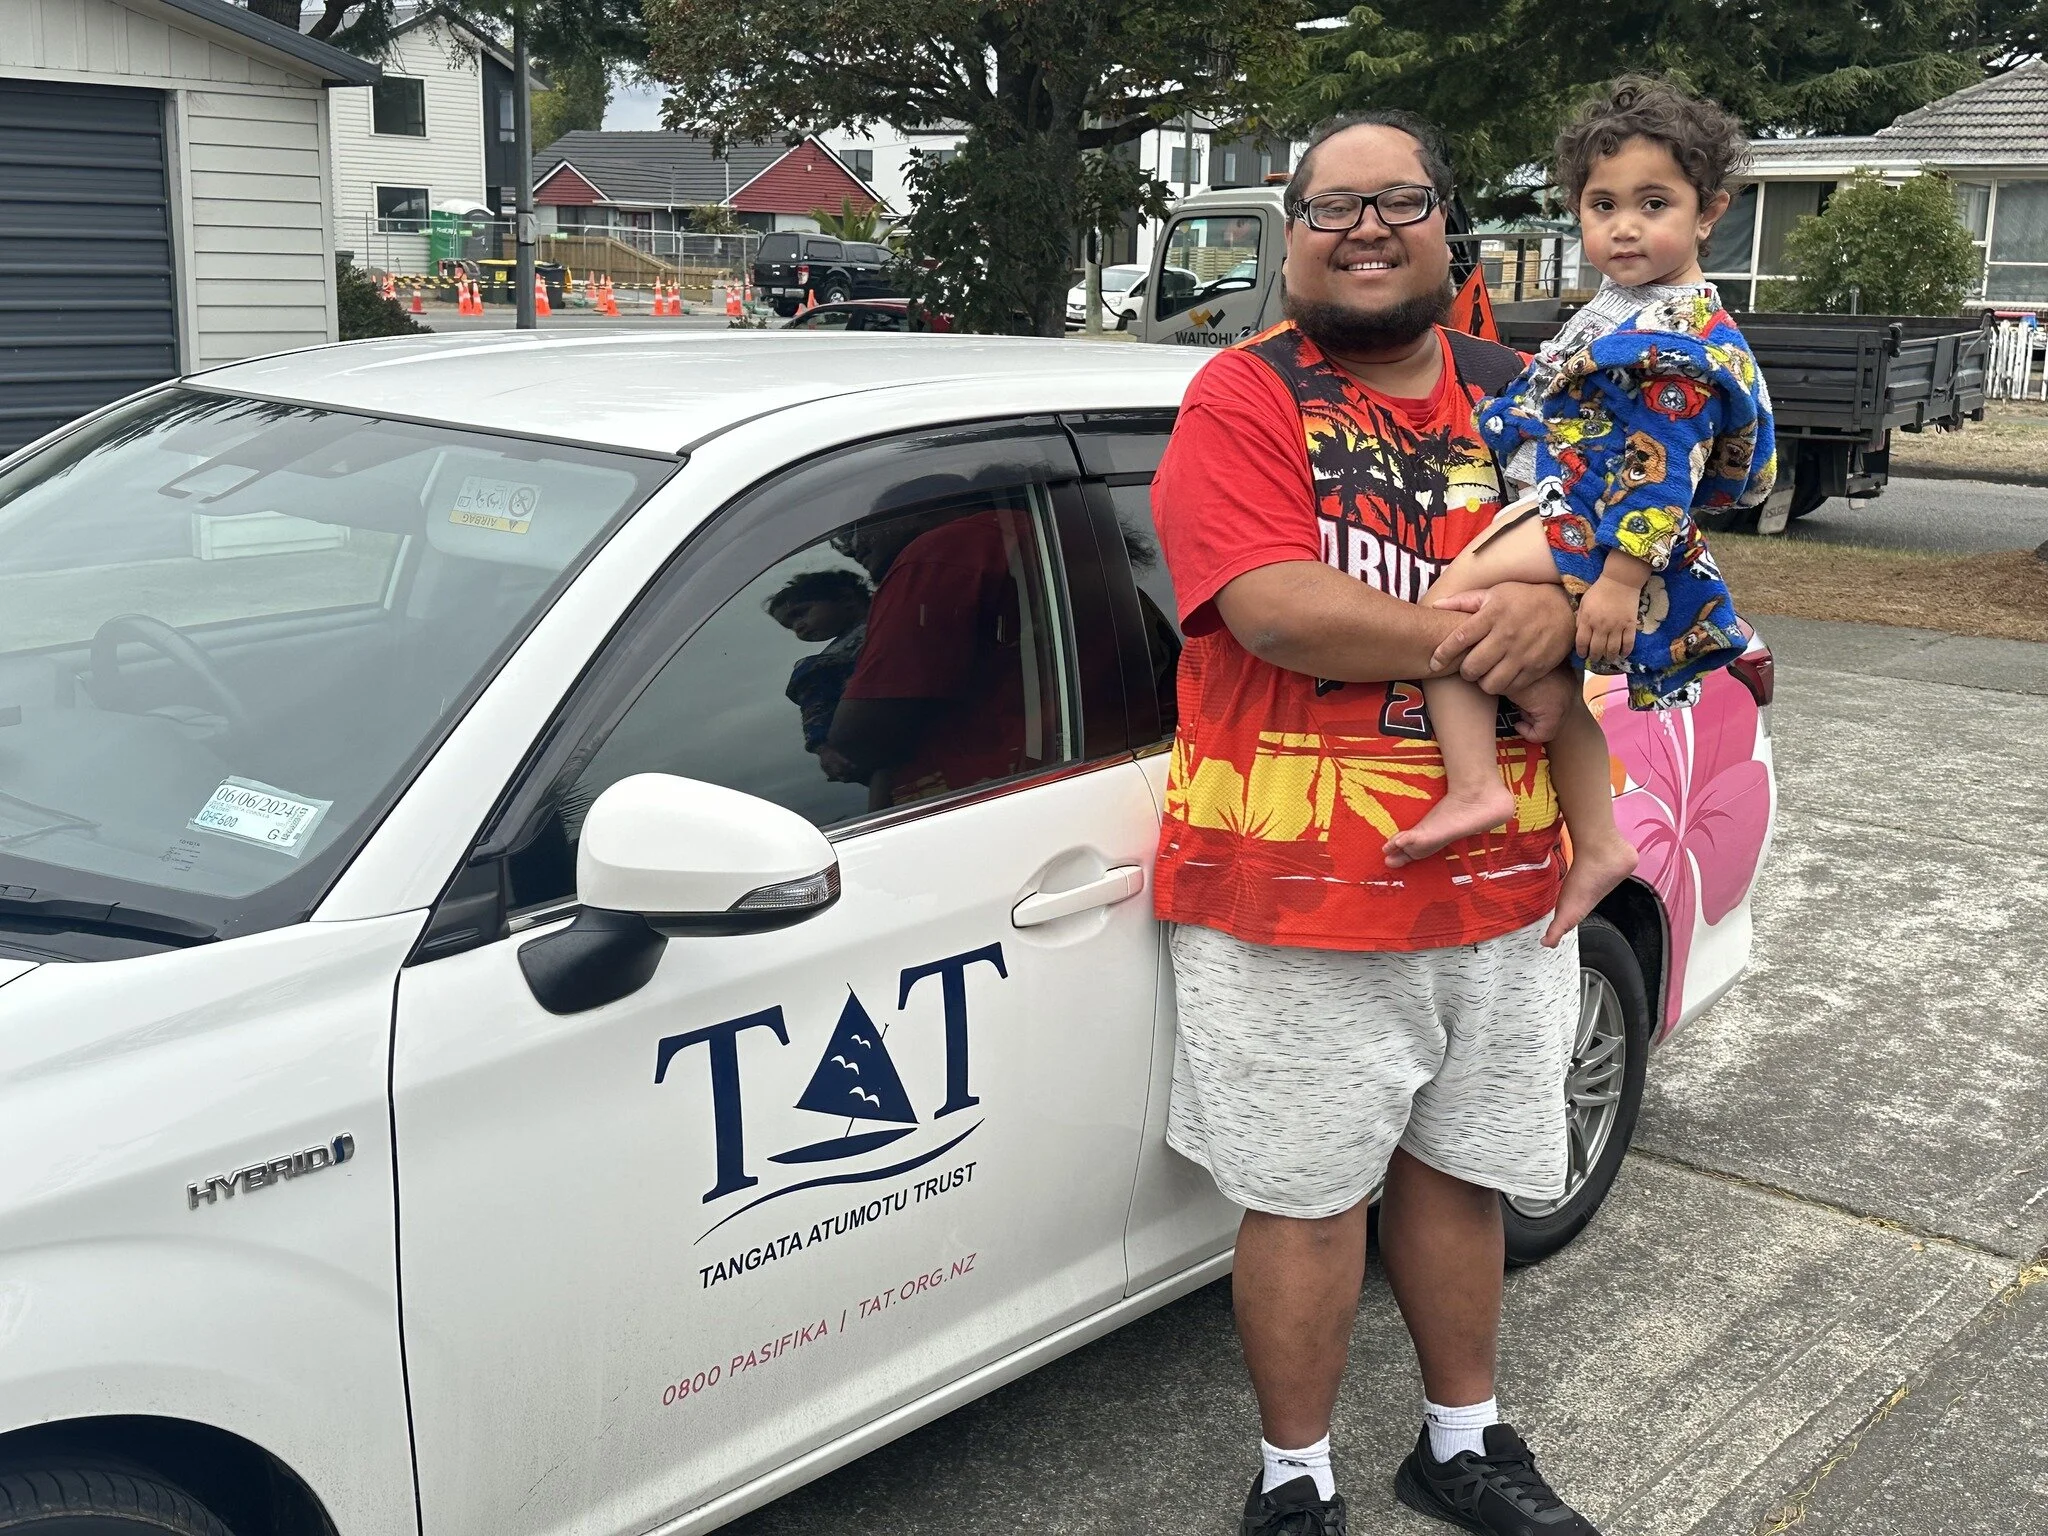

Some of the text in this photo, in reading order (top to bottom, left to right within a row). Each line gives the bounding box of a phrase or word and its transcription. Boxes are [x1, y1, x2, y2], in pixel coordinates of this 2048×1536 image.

[1175, 331, 1239, 346] WAITOHI
[461, 513, 497, 527] AIRBAG
[216, 787, 295, 818] 06/06/2024
[201, 811, 239, 828] QHF600
[267, 828, 280, 841] G
[654, 941, 1009, 1204] TAT
[187, 1144, 330, 1211] HYBRID
[699, 1161, 977, 1290] TANGATA ATUMOTU TRUST
[661, 1364, 722, 1407] 0800
[729, 1318, 829, 1379] PASIFIKA
[858, 1252, 978, 1321] TAT.ORG.NZ
